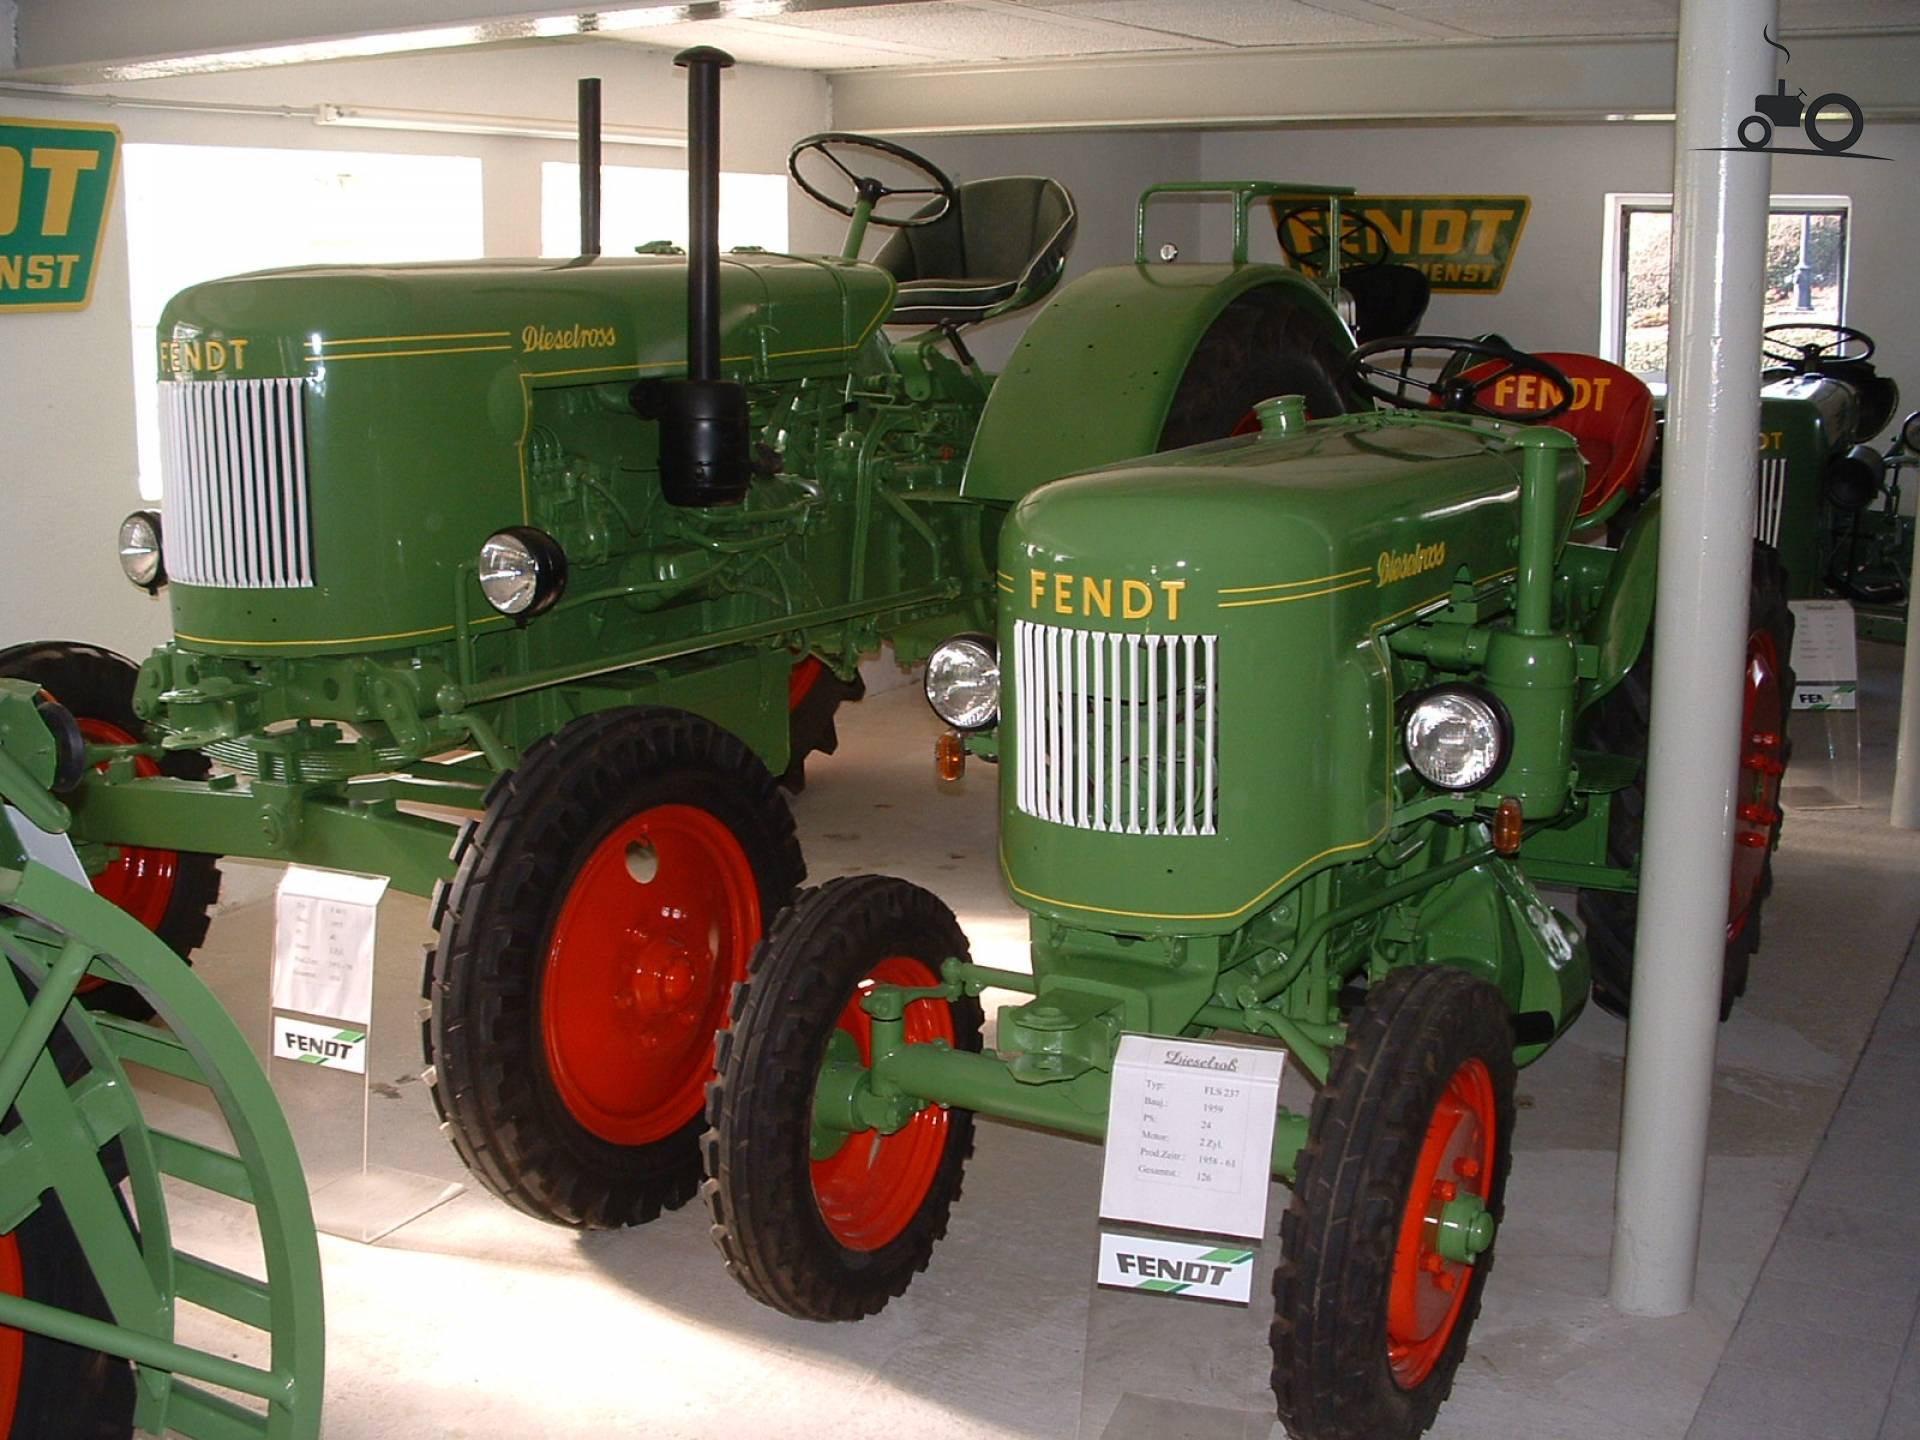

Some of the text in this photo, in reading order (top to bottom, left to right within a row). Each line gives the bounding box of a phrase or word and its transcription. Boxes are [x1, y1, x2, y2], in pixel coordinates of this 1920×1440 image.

[1285, 209, 1513, 255] FENDT
[522, 323, 616, 353] Dieselross
[160, 338, 249, 373] FENDT
[1494, 374, 1611, 412] FENDT
[1031, 568, 1186, 621] FENDT
[285, 1032, 353, 1060] FENDT
[1204, 1086, 1223, 1097] FLS
[1224, 1088, 1240, 1098] 237
[1201, 1121, 1212, 1130] 24
[1116, 1253, 1232, 1286] FENDT
